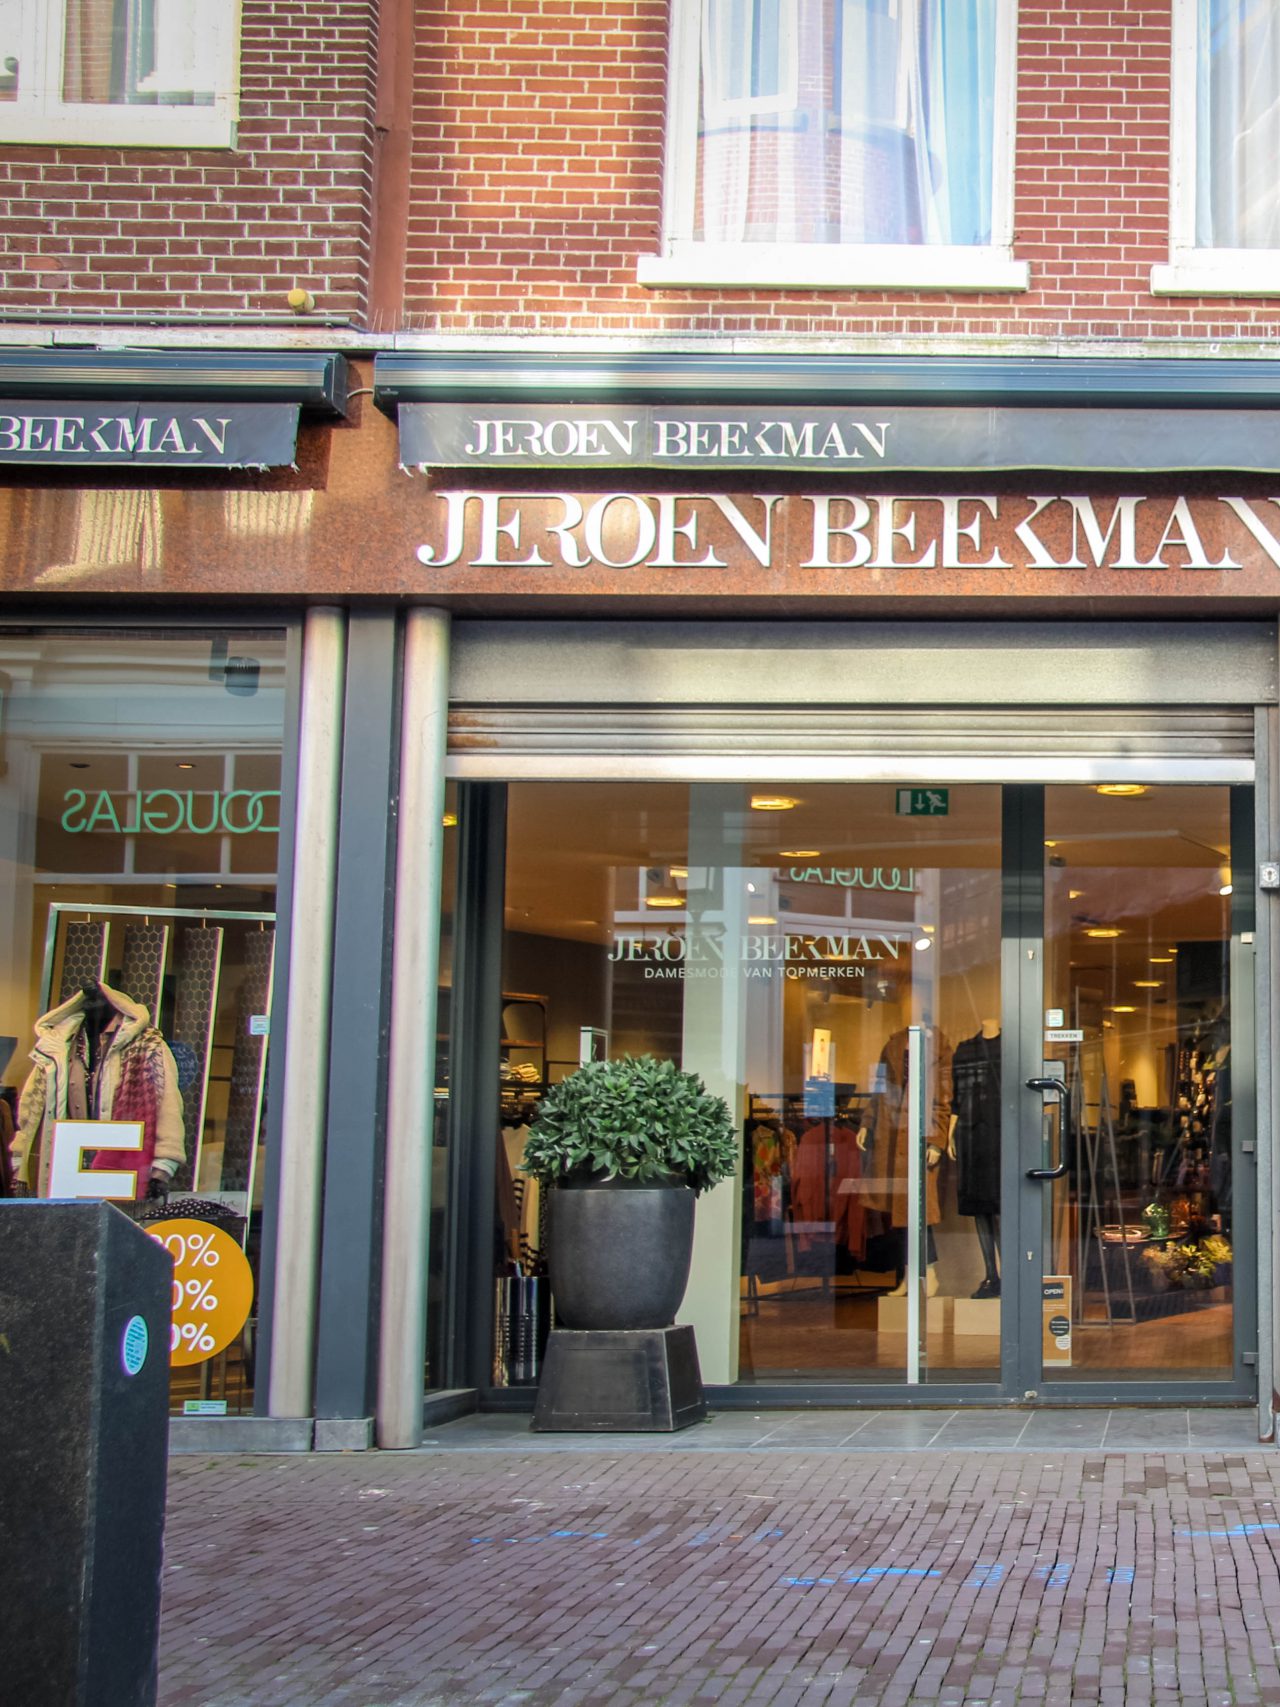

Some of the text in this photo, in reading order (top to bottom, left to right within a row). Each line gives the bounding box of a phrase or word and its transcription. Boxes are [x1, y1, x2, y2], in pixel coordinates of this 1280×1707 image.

[465, 419, 892, 458] JEROEN BEEKMAN
[415, 491, 789, 569] JEROEN
[607, 934, 902, 961] JEROEN BEEKMAN
[645, 966, 865, 979] DAMESMODE VAN TOPMERKEN
[150, 1233, 220, 1267] 0%
